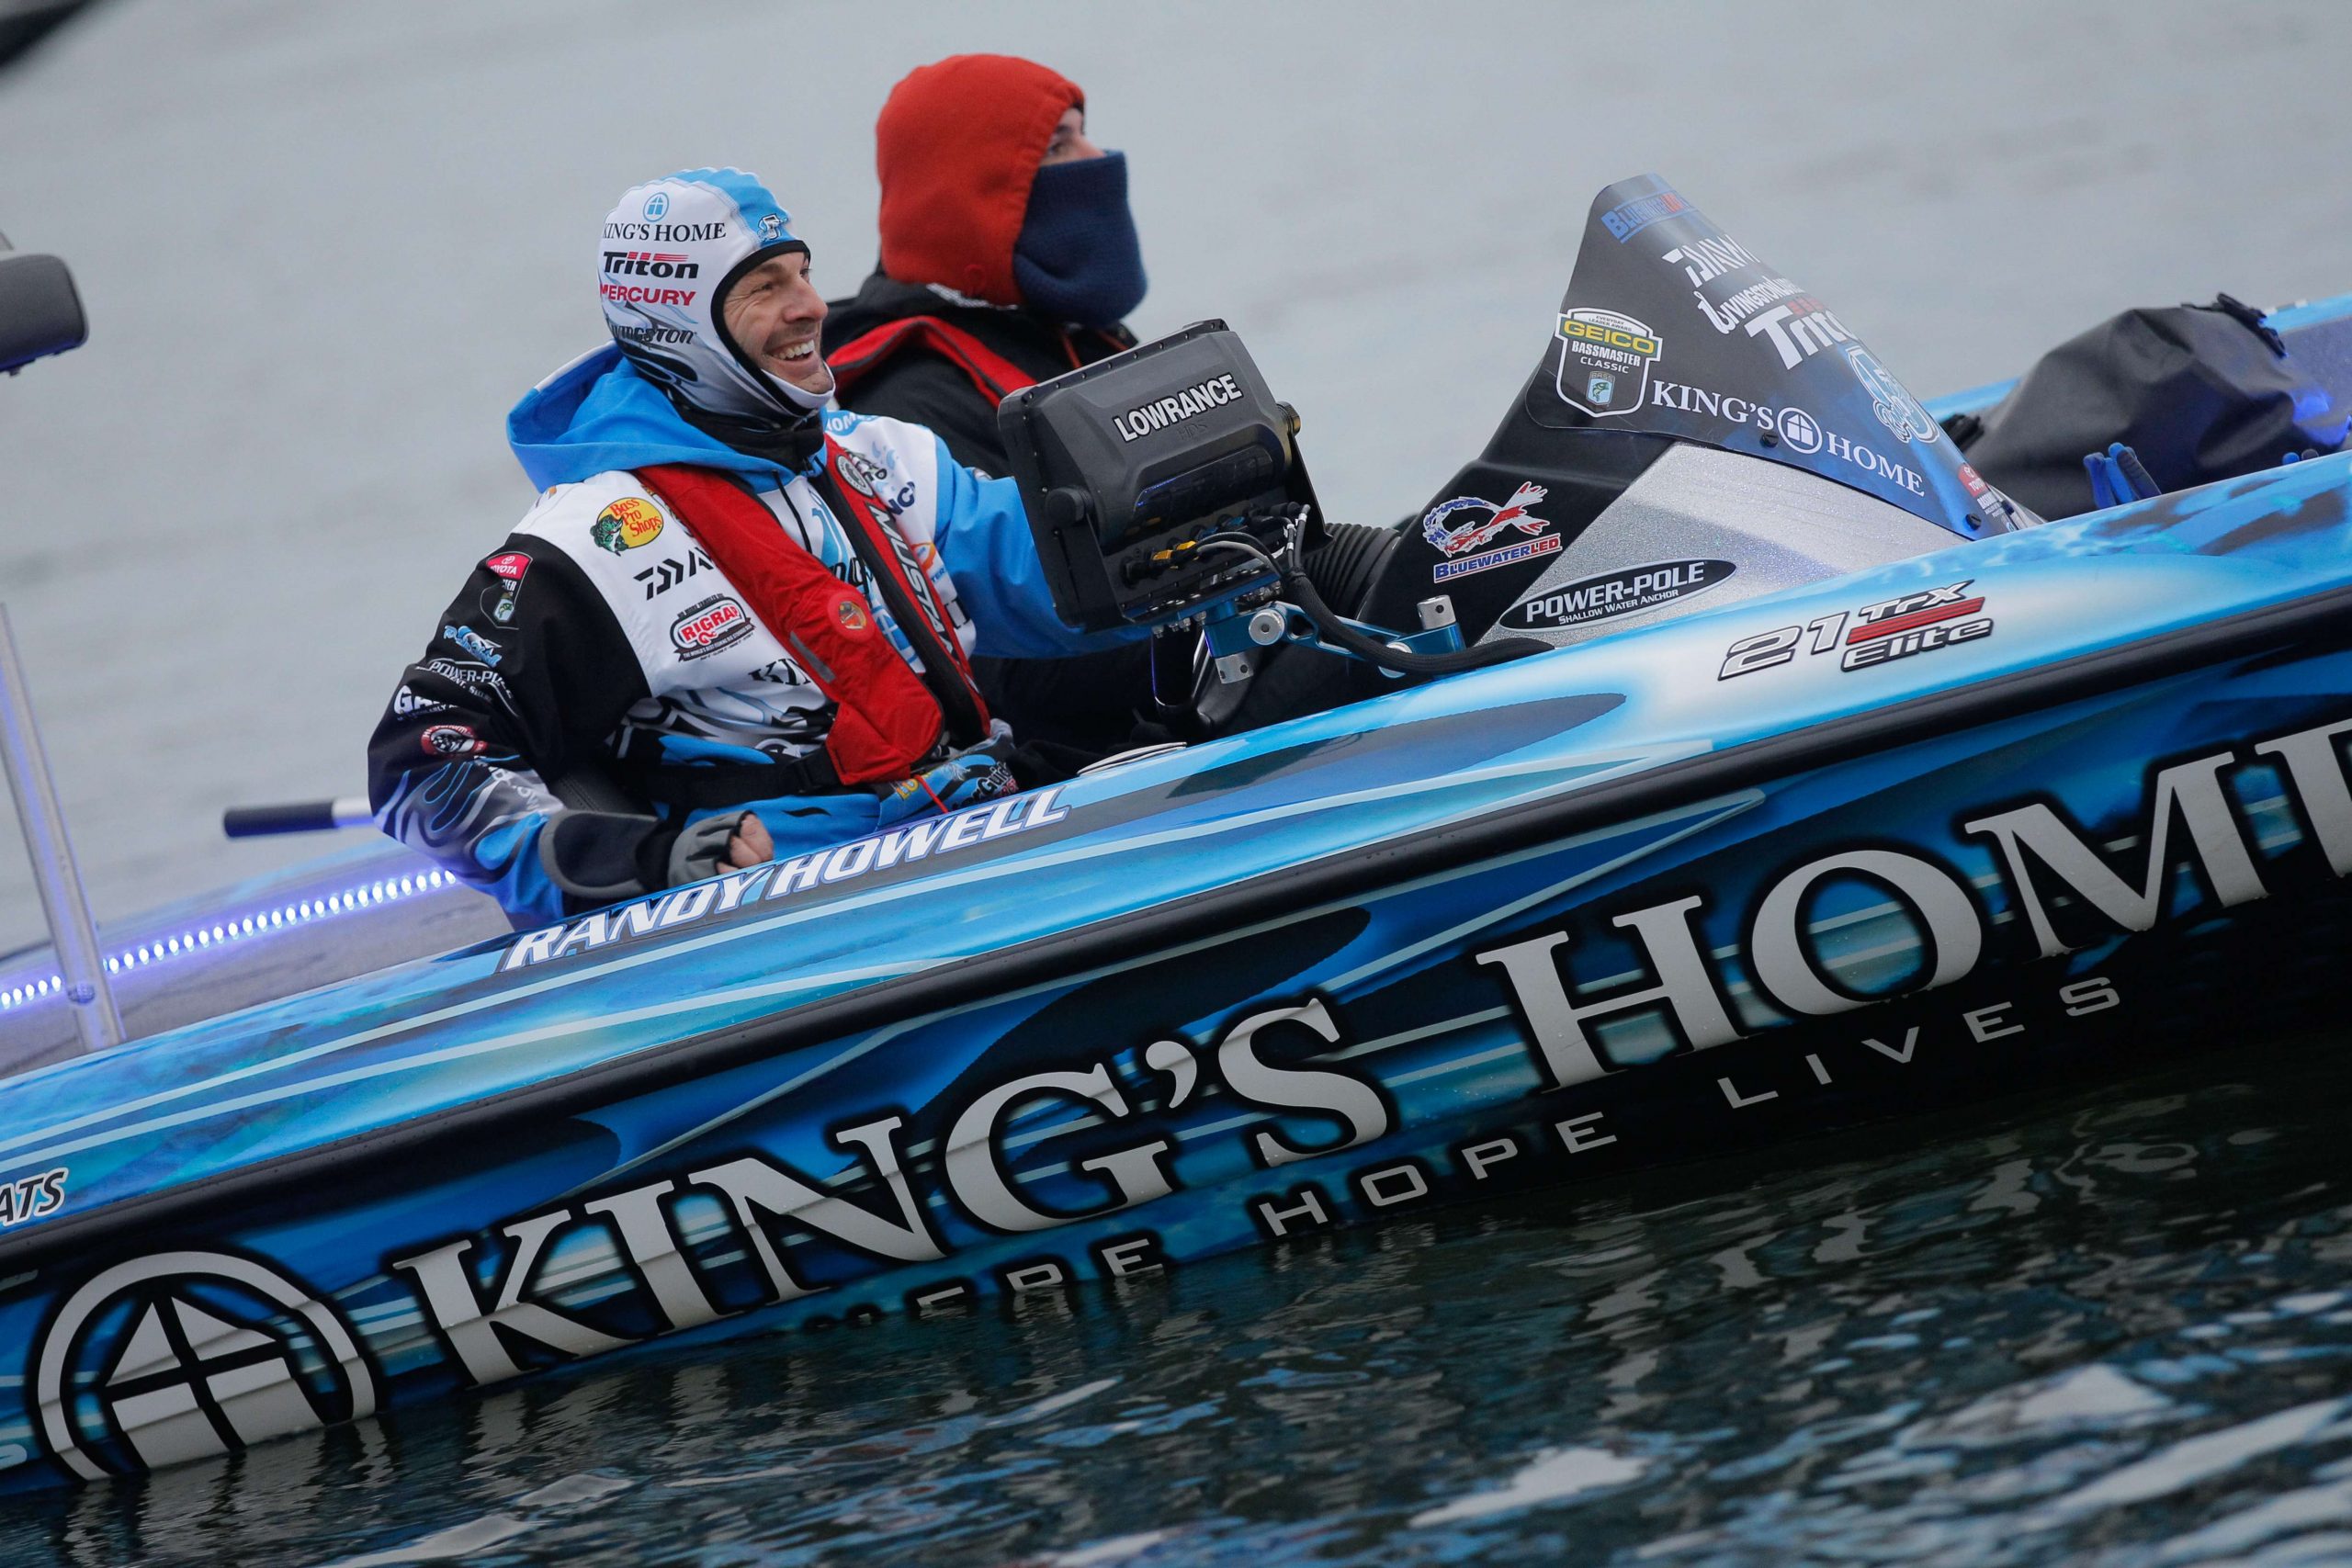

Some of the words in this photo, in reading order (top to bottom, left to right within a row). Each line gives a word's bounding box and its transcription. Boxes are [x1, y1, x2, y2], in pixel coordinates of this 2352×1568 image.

[653, 222, 727, 243] HOME
[604, 251, 699, 279] Triton
[600, 283, 696, 307] MERCURY
[1564, 320, 1655, 355] GEICO
[1571, 341, 1641, 367] BASSMASTER
[1580, 356, 1630, 374] CLASSIC
[1114, 373, 1243, 442] LOWRANCE
[1651, 379, 1774, 431] KING'S
[1826, 431, 1925, 497] HOME
[610, 498, 640, 516] Bass
[622, 510, 642, 525] Pro
[629, 516, 662, 537] Shops
[1435, 537, 1560, 579] BLUEWATERLED
[1526, 561, 1706, 623] POWER-POLE
[1558, 607, 1603, 626] SHALLOW
[1604, 598, 1638, 614] WATER
[1640, 589, 1679, 604] ANCHOR
[1718, 611, 1849, 682] 21
[1840, 617, 1994, 672] Elite
[503, 866, 771, 972] RANDY
[764, 786, 1069, 897] HOWELL
[1717, 976, 2120, 1109] LIVES
[392, 998, 1389, 1385] KING'S
[1258, 1111, 1618, 1237] HOPE
